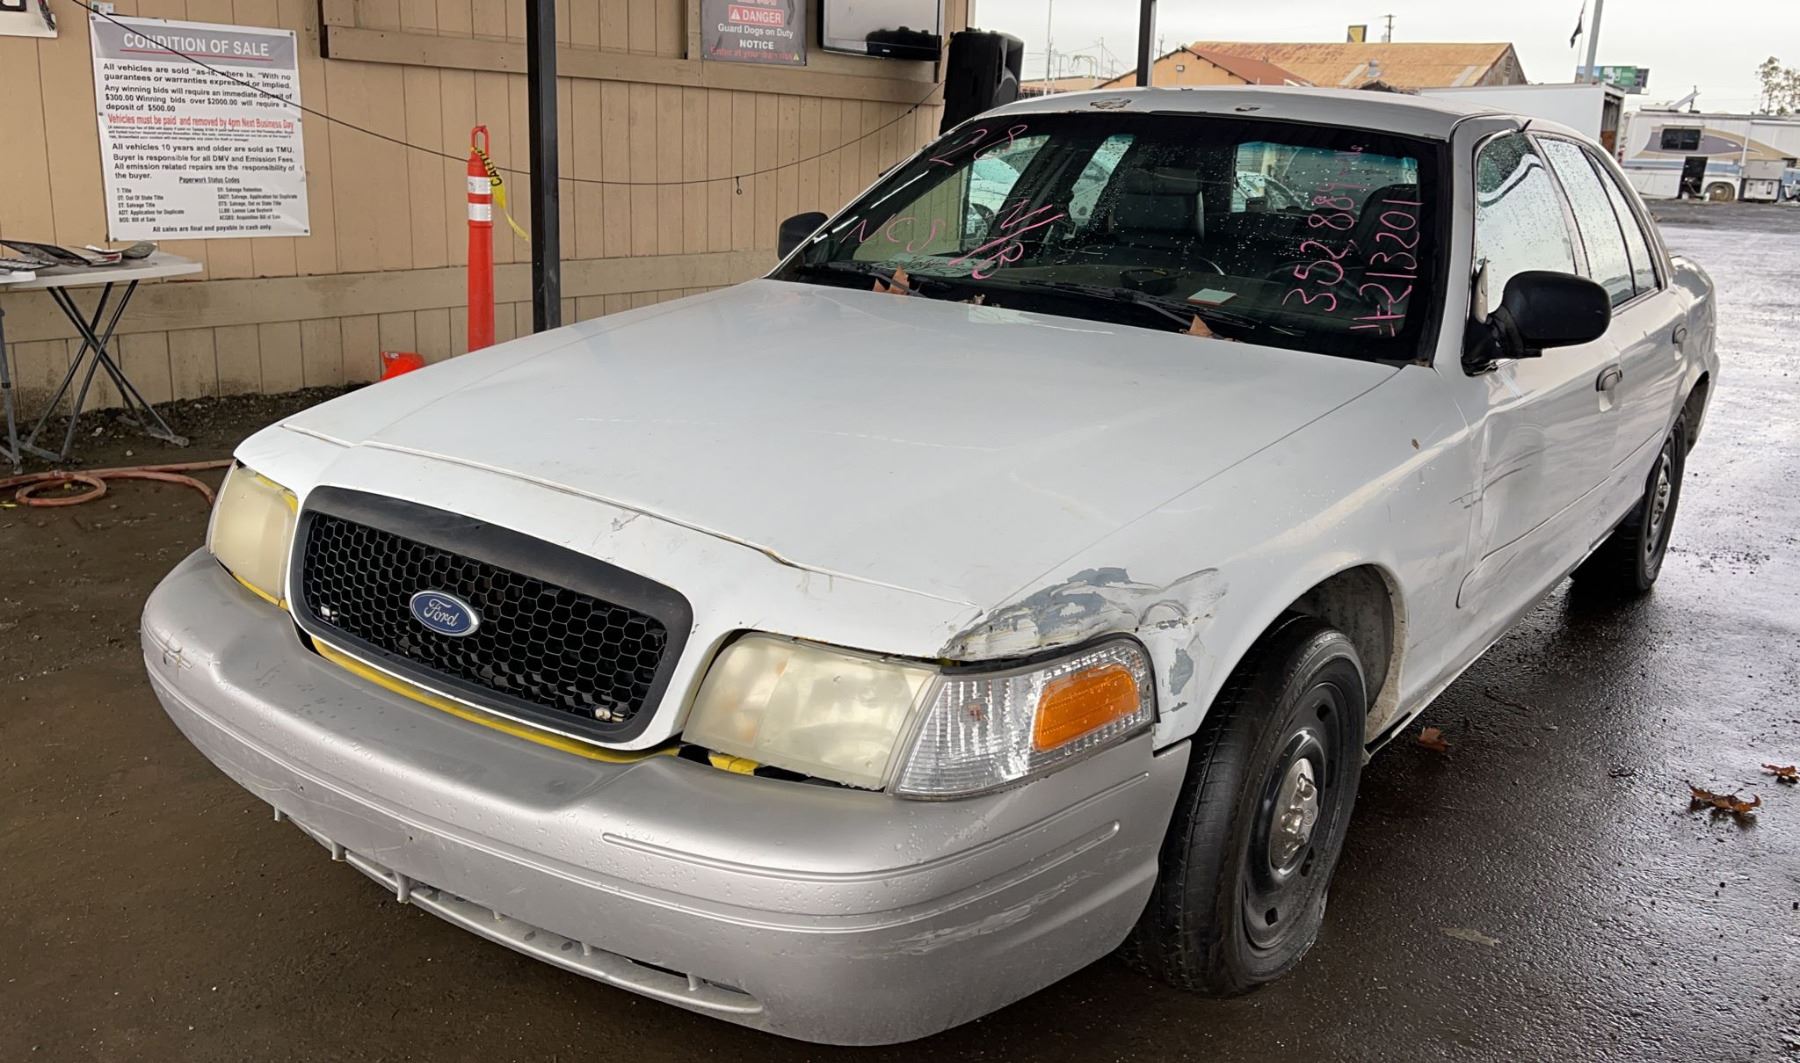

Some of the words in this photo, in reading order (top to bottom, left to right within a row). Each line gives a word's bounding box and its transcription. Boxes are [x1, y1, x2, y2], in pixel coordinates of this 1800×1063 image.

[742, 9, 781, 24] DANGER
[717, 23, 742, 33] Guard
[744, 25, 764, 36] Dogs
[776, 28, 793, 39] Duty
[123, 33, 206, 52] CONDITION
[210, 39, 229, 53] OF
[233, 40, 270, 57] SALE
[739, 39, 774, 49] NOTICE
[103, 63, 115, 71] All
[117, 64, 153, 72] vehicles
[171, 67, 189, 75] sold
[104, 73, 151, 82] guarantees
[165, 76, 207, 84] warranties
[105, 84, 120, 93] Any
[122, 85, 151, 94] winning
[153, 86, 169, 94] bids
[222, 90, 257, 98] immediate
[105, 93, 134, 101] $300.00
[136, 95, 166, 104] Winning
[170, 96, 186, 104] bids
[105, 103, 134, 111] deposit
[148, 104, 176, 112] $500.00
[108, 113, 135, 124] Vehicles
[136, 115, 152, 124] must
[153, 116, 162, 125] be
[163, 116, 176, 126] paid
[179, 116, 191, 126] and
[192, 117, 218, 126] removed
[219, 118, 227, 129] by
[228, 118, 240, 129] 4pm
[241, 118, 255, 128] Next
[256, 118, 282, 128] Business
[125, 143, 159, 151] vehicles
[196, 144, 210, 152] and
[113, 153, 135, 162] Buyer
[146, 154, 189, 162] responsible
[114, 162, 124, 170] All
[188, 163, 213, 171] repairs
[242, 164, 287, 172] responsibility
[178, 176, 206, 184] Paperwork
[423, 599, 460, 627] Ford
